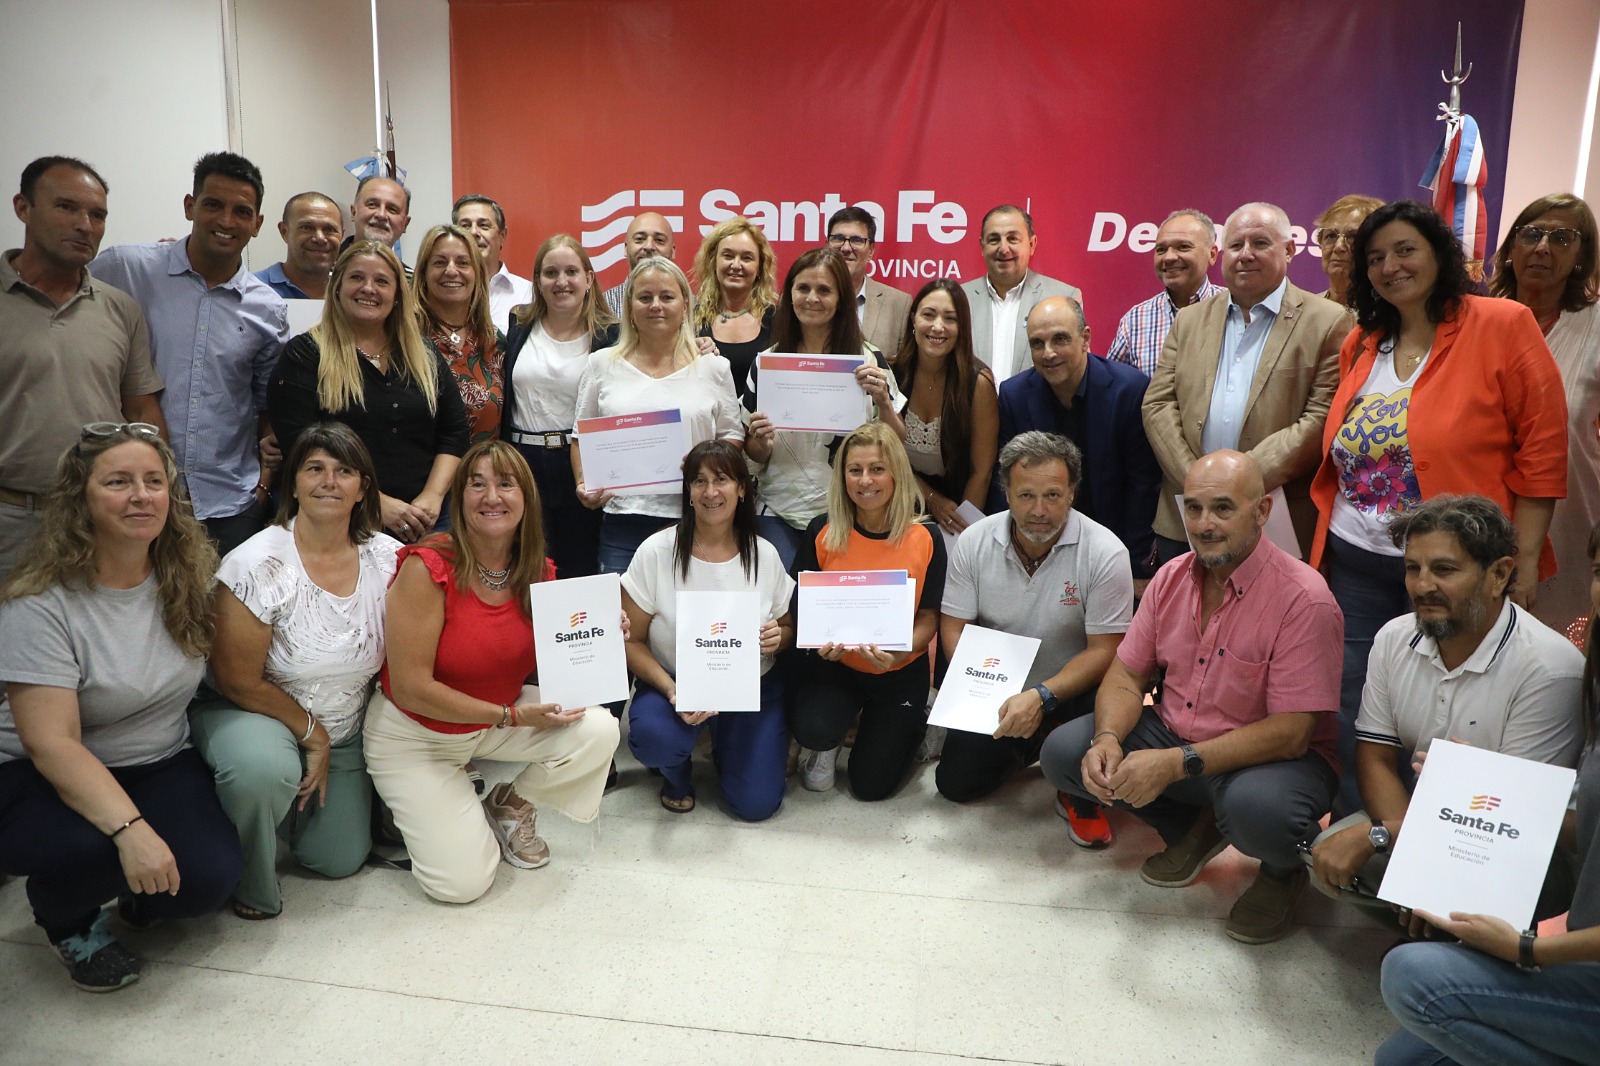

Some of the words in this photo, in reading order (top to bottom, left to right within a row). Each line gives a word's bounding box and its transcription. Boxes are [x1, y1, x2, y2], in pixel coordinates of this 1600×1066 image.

[897, 190, 967, 244] Fe
[865, 258, 962, 279] OVINCIA
[1355, 397, 1408, 426] Lov
[555, 630, 590, 643] Santa
[591, 627, 605, 638] Fe
[695, 638, 728, 648] Santa
[730, 638, 742, 648] Fe
[965, 666, 995, 681] Santa
[996, 673, 1008, 682] Fe
[1438, 807, 1495, 833] Santa
[1497, 822, 1520, 839] Fe
[1454, 828, 1494, 844] PROVINCIA
[1448, 845, 1480, 858] Ministerio
[1450, 852, 1484, 866] Educación
